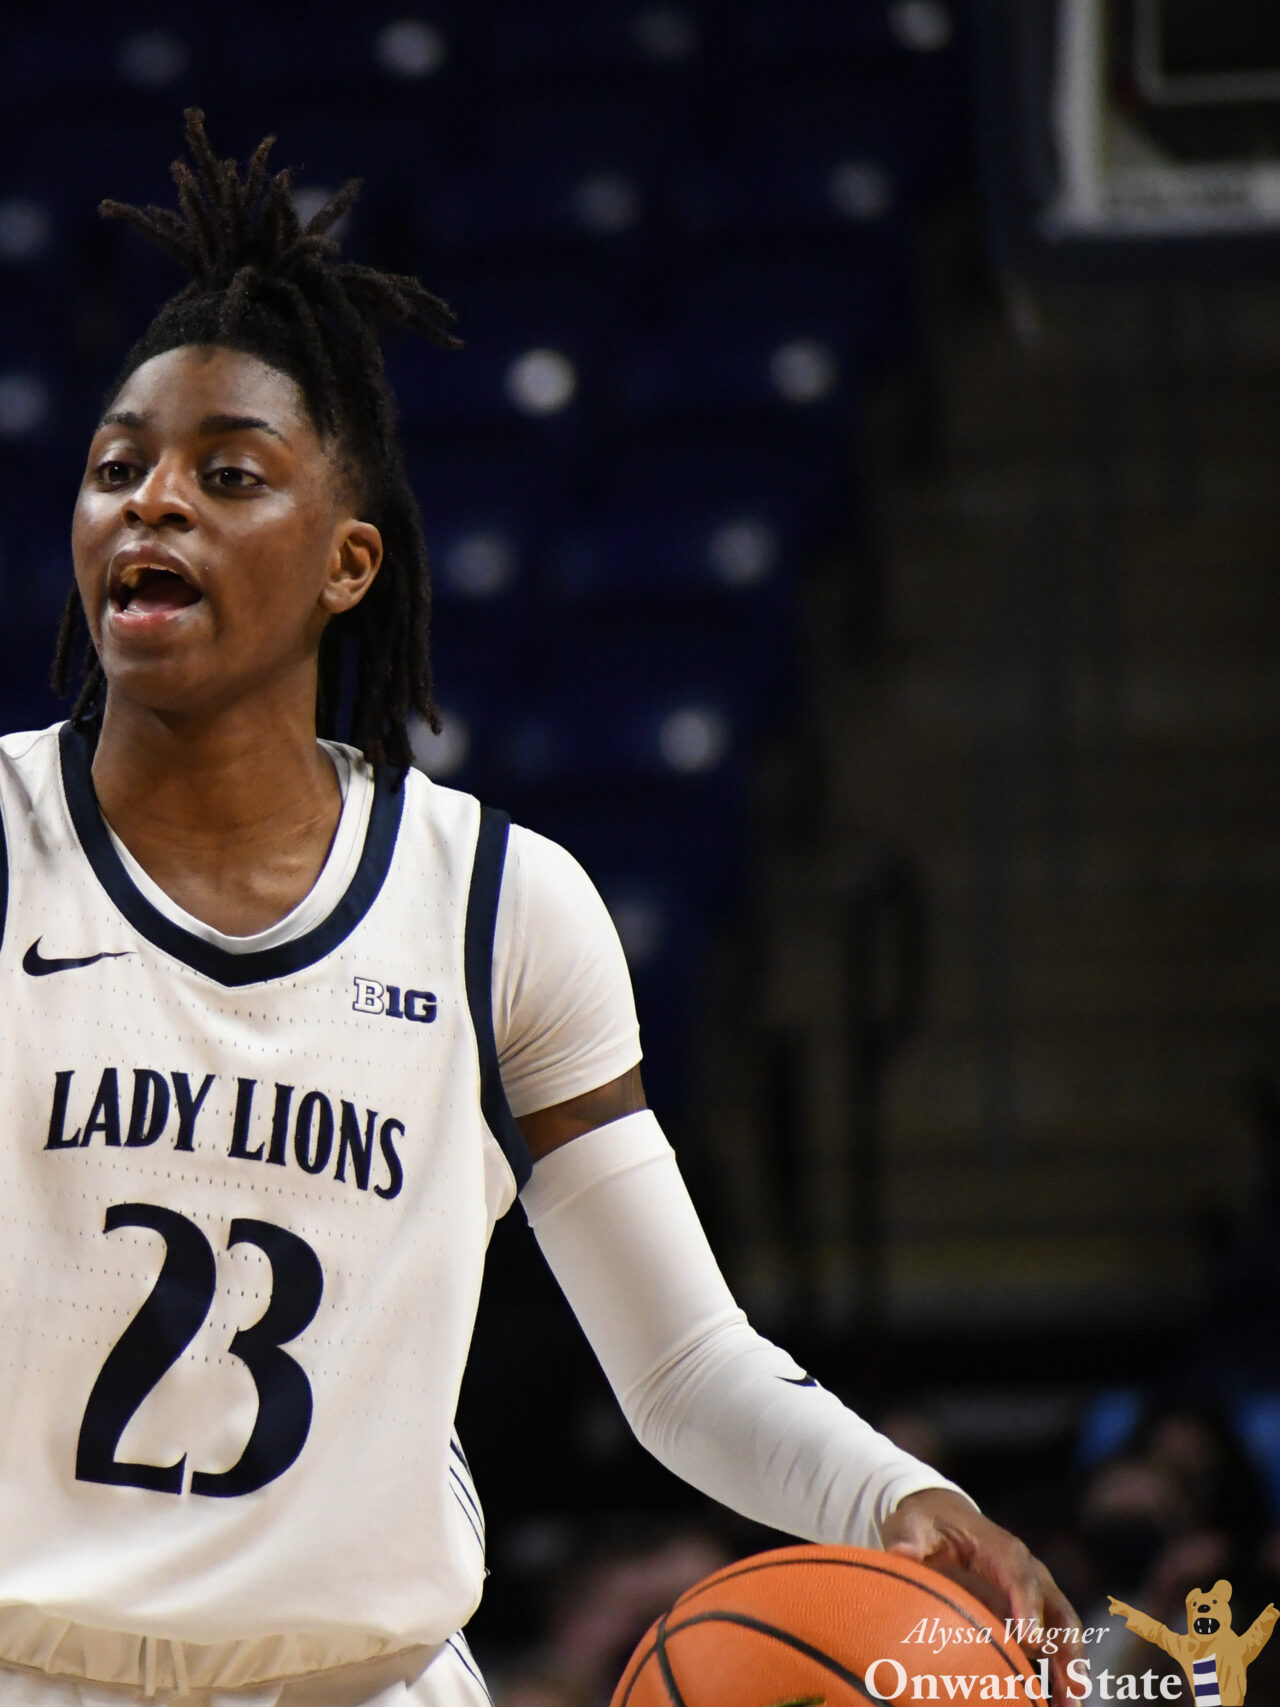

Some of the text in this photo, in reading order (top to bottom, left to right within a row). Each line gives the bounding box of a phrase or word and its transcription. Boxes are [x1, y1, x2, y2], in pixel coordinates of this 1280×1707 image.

[43, 1067, 406, 1200] LADY LIONS
[75, 1203, 324, 1498] 23
